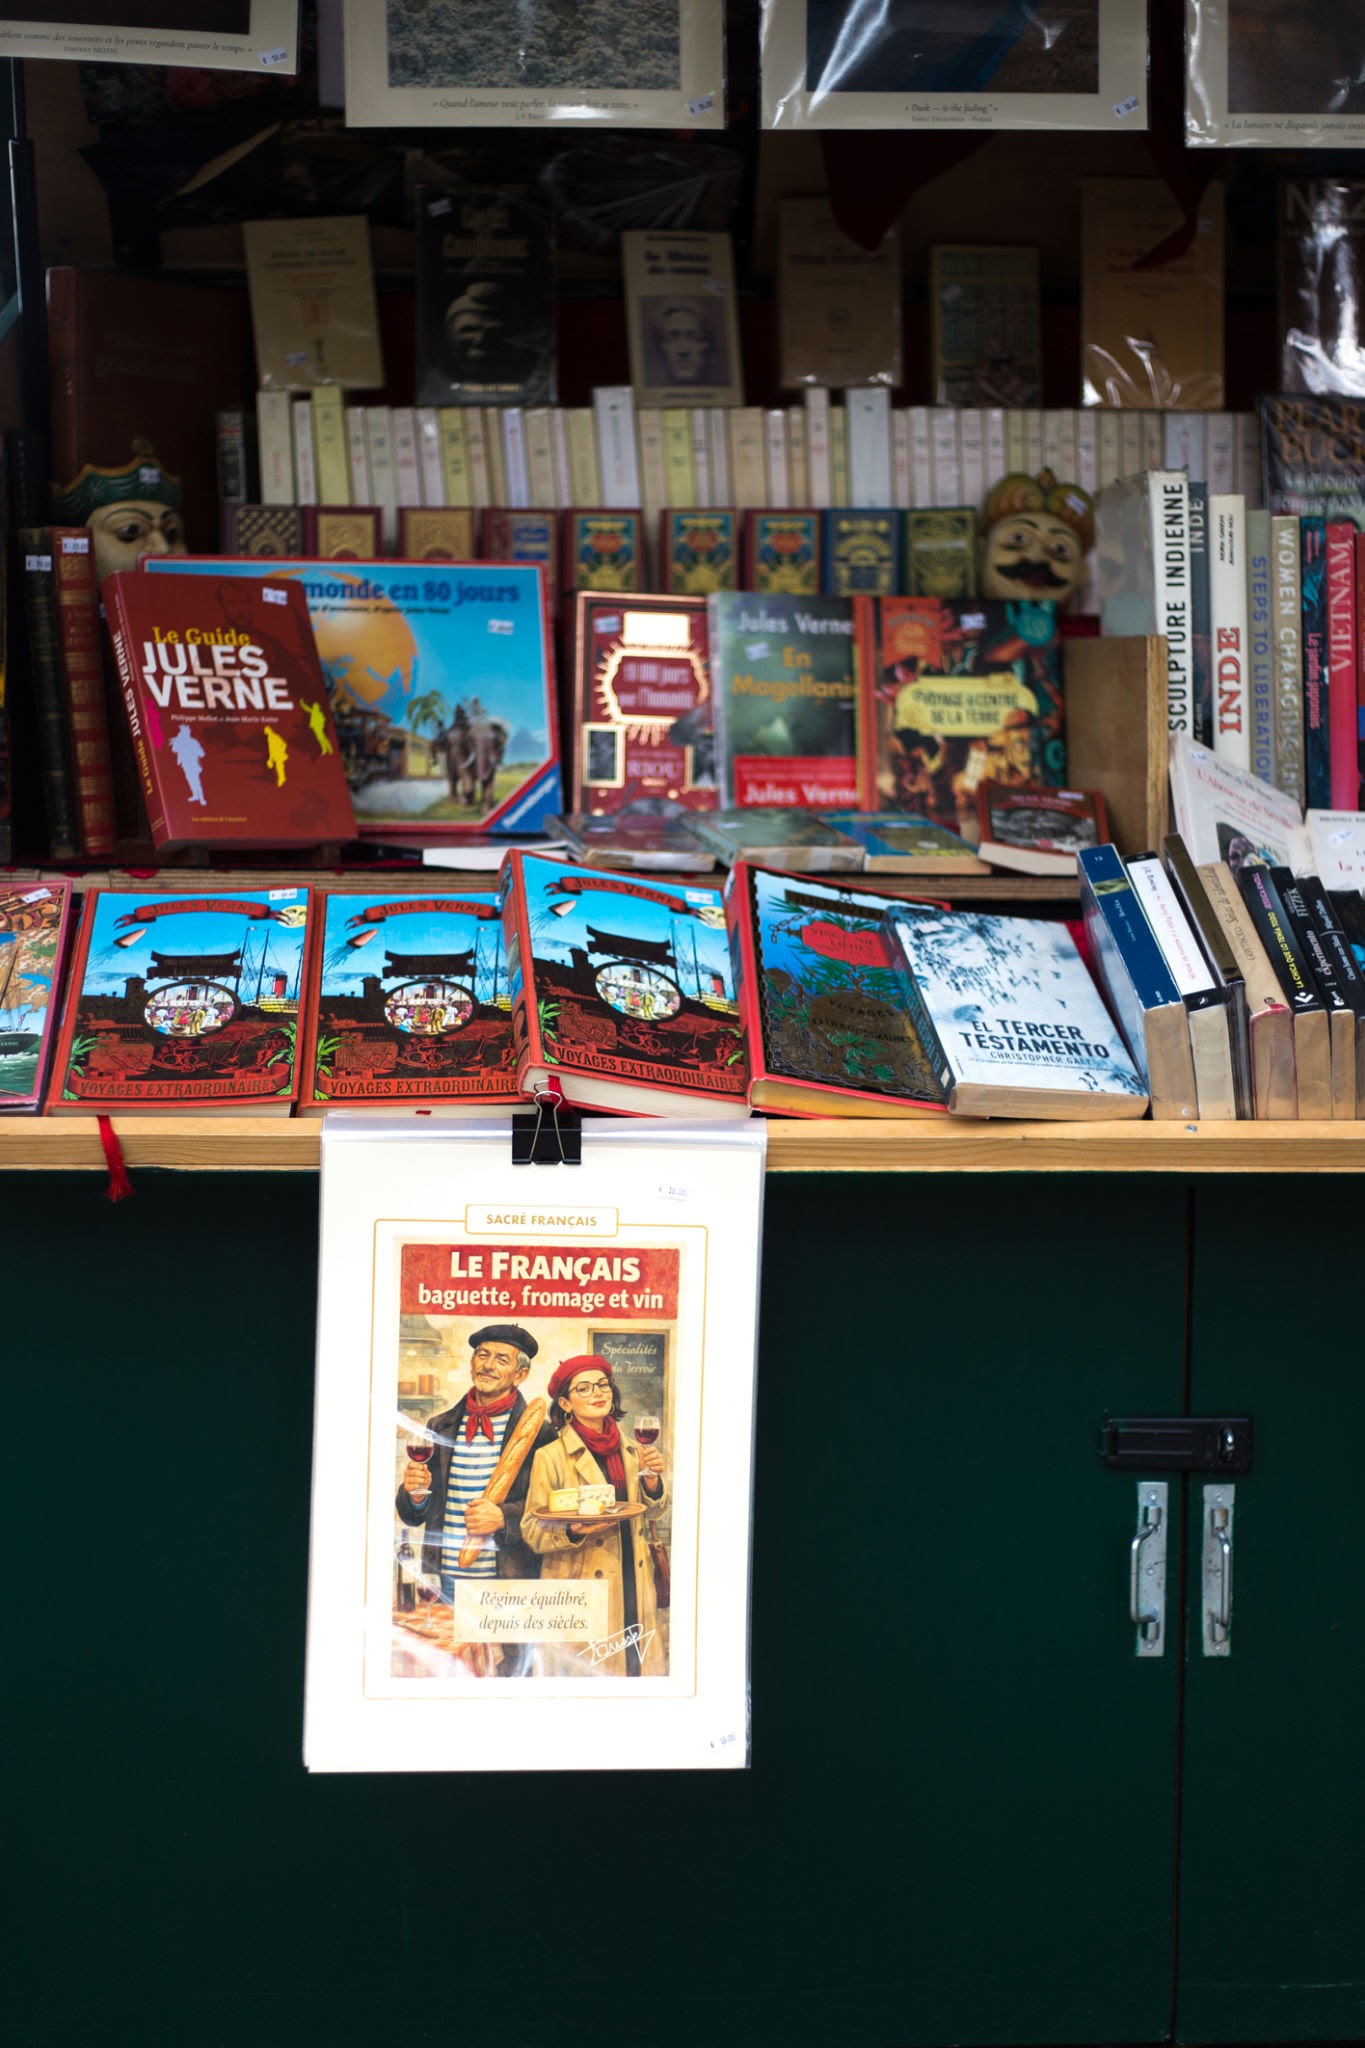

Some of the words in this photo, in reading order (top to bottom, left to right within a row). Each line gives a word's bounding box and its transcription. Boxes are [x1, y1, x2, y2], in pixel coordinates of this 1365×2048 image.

[52, 33, 65, 41] des
[115, 35, 125, 44] les
[149, 39, 186, 49] regardent
[213, 42, 220, 50] le
[440, 98, 467, 109] Quand
[912, 103, 930, 111] Dusk
[1163, 483, 1186, 587] INDIENNE
[1189, 498, 1204, 553] INDE
[1277, 528, 1296, 616] WOMEN
[303, 578, 384, 600] monde
[388, 582, 417, 600] en
[422, 580, 449, 600] 80
[454, 580, 520, 606] jours
[1252, 555, 1268, 623] STEPS
[738, 610, 789, 633] Jules
[794, 612, 855, 635] Verne
[152, 626, 179, 644] Le
[186, 628, 250, 647] Guide
[1254, 627, 1268, 657] TO
[1308, 632, 1322, 646] Le
[113, 632, 130, 686] VERNE
[142, 641, 269, 678] JULES
[782, 646, 812, 669] En
[1166, 600, 1188, 732] SCULPTURE
[1306, 647, 1322, 680] jardin
[144, 674, 294, 710] VERNE
[1216, 626, 1242, 735] INDE
[1279, 626, 1299, 750] CHANGING
[124, 688, 142, 737] JULES
[1306, 681, 1321, 729] japonais
[170, 714, 196, 723] Philippe
[1253, 664, 1272, 785] LIBERATION
[137, 739, 150, 776] Guide
[145, 777, 153, 795] Le
[743, 784, 796, 804] Jules
[574, 877, 619, 891] JULES
[624, 883, 675, 906] VERNE
[151, 901, 200, 915] JULES
[205, 900, 256, 913] VERNE
[379, 902, 427, 916] JULES
[432, 900, 484, 913] VERNE
[1267, 911, 1279, 927] TODO
[1280, 943, 1289, 951] LO
[1283, 951, 1295, 963] QUE
[1306, 929, 1332, 976] experimento
[1289, 963, 1301, 981] CHICA
[1297, 980, 1304, 989] LA
[829, 999, 897, 1017] VOYAGES
[971, 1020, 993, 1032] EL
[995, 1018, 1085, 1041] TERCER
[958, 1031, 1110, 1058] TESTAMENTO
[557, 1046, 617, 1071] VOYAGES
[620, 1062, 745, 1092] EXTRAORDINAIRES
[990, 1051, 1063, 1064] CHRISTOPHER
[1066, 1056, 1093, 1066] GALT
[78, 1080, 142, 1097] VOYAGES
[145, 1077, 279, 1096] EXTRAORDINAIRES
[330, 1080, 392, 1096] VOYAGES
[396, 1078, 518, 1095] EXTRAORDINAIRE
[486, 1211, 527, 1226] SACRÉ
[531, 1214, 598, 1230] FRANÇAIS
[450, 1251, 484, 1279] LE
[491, 1251, 641, 1287] FRANÇAIS
[417, 1283, 517, 1311] baguette,
[521, 1284, 605, 1312] fromage
[608, 1290, 630, 1307] et
[632, 1289, 663, 1309] vin
[601, 1341, 657, 1359] Spécialités
[611, 1361, 623, 1373] du
[625, 1360, 657, 1374] Terroir
[479, 1590, 527, 1609] Régime
[530, 1590, 588, 1610] équilibré,
[478, 1614, 520, 1635] depuis
[523, 1614, 544, 1630] des
[547, 1614, 588, 1630] siècles.
